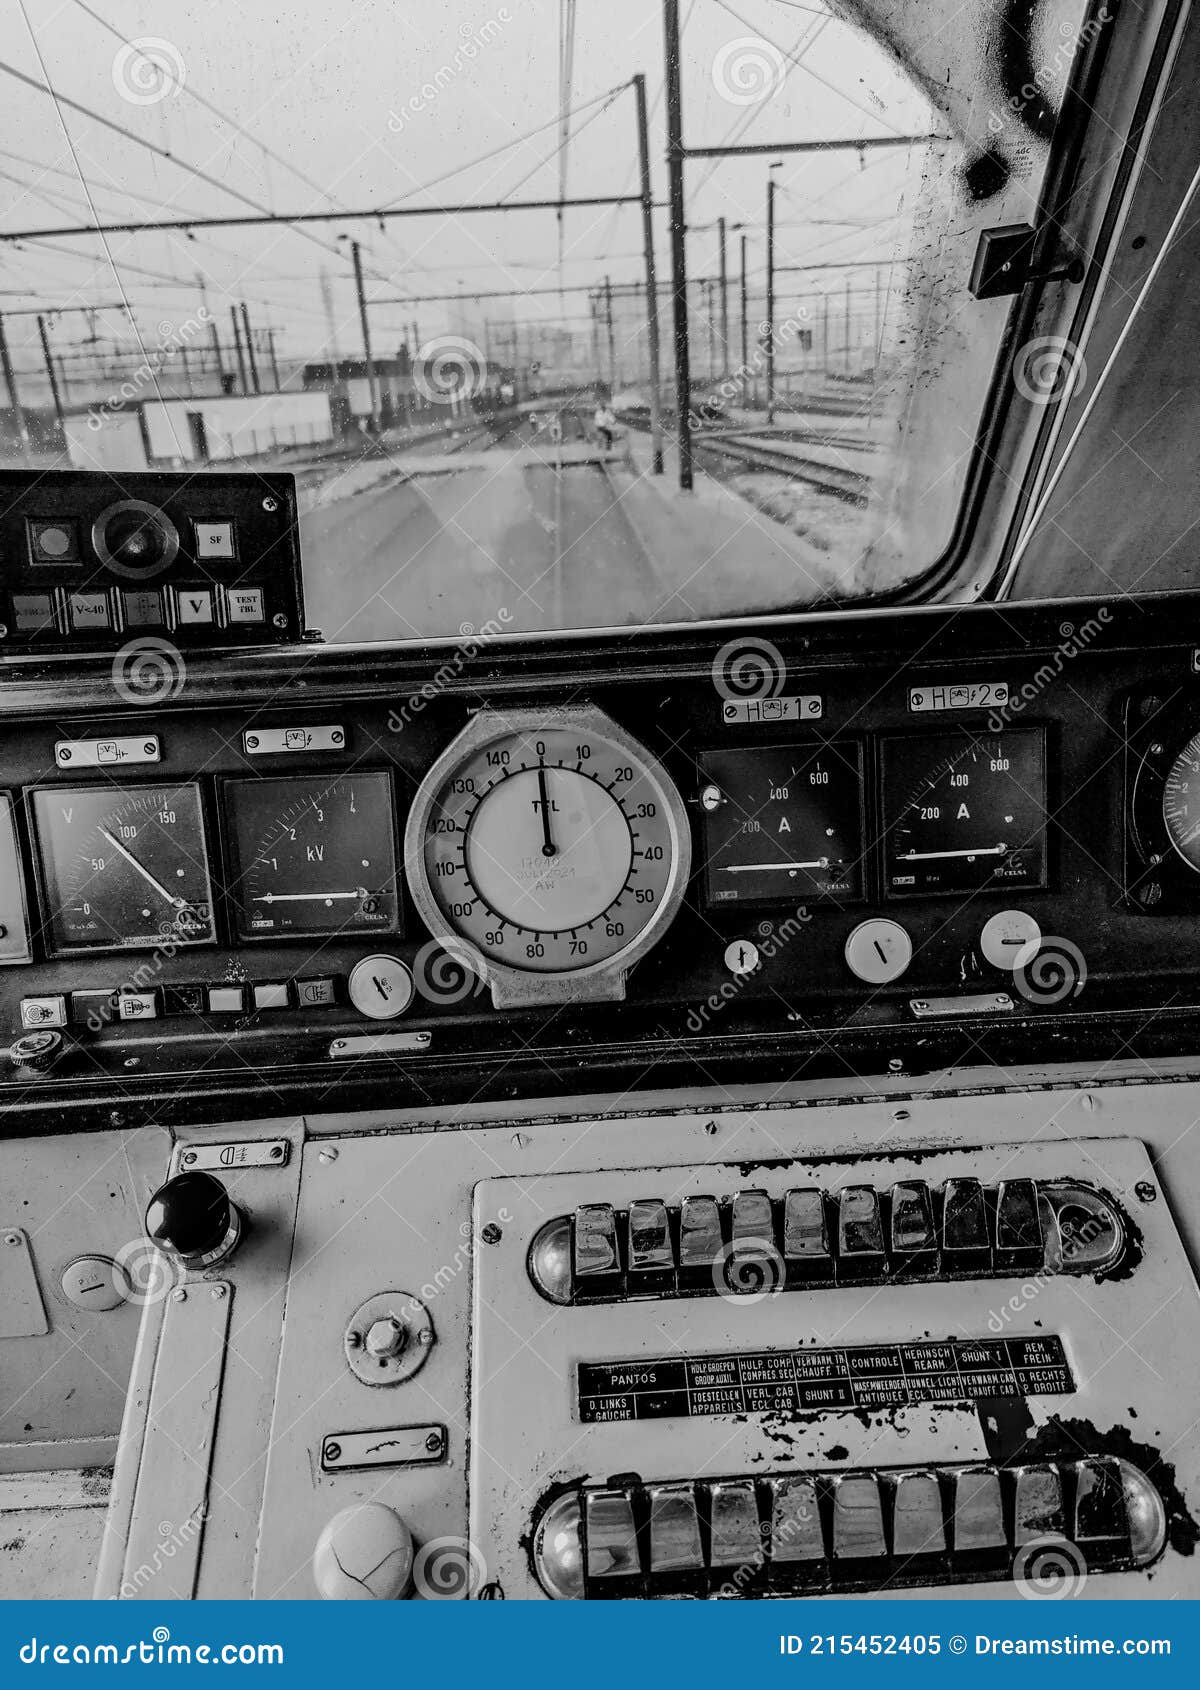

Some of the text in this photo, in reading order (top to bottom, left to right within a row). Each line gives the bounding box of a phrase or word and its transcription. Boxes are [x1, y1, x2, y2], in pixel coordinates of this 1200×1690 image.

[209, 535, 223, 545] SF
[235, 595, 258, 605] TEST
[75, 604, 105, 615] V<40
[188, 600, 204, 614] V
[238, 605, 257, 614] TBL
[979, 684, 991, 706] 2
[794, 697, 802, 720] 1
[535, 741, 546, 756] 0
[576, 745, 591, 760] 10
[486, 751, 511, 766] 140
[990, 759, 1010, 772] 600
[615, 767, 633, 782] 20
[810, 772, 829, 785] 600
[950, 774, 969, 787] 400
[451, 778, 475, 794] 130
[1182, 782, 1190, 794] 2
[770, 787, 789, 800] 400
[532, 800, 560, 814] TL
[637, 803, 656, 818] 30
[920, 807, 940, 819] 200
[957, 803, 970, 819] A
[62, 807, 73, 824] V
[158, 810, 176, 824] 150
[317, 809, 324, 822] 3
[431, 818, 456, 834] 120
[742, 821, 760, 833] 200
[778, 817, 791, 833] A
[119, 825, 137, 839] 100
[289, 828, 297, 840] 2
[306, 845, 324, 862] kV
[644, 846, 664, 861] 40
[92, 858, 105, 871] 50
[271, 858, 278, 871] 1
[435, 862, 455, 877] 110
[635, 889, 655, 904] 50
[83, 903, 90, 915] 0
[449, 902, 473, 918] 100
[605, 922, 625, 937] 60
[485, 931, 504, 946] 90
[526, 944, 545, 958] 80
[568, 941, 588, 956] 70
[1024, 1342, 1045, 1353] REM
[851, 1356, 899, 1368] CONTROLE
[961, 1350, 991, 1362] SHUNT
[611, 1373, 657, 1385] PANTOS
[1029, 1370, 1066, 1381] RECHTS
[907, 1377, 936, 1389] TUNNEL
[692, 1390, 740, 1403] TOESTELLEN
[805, 1389, 834, 1401] SHUNT
[929, 1387, 963, 1399] TUNNEL
[600, 1398, 627, 1410] LINKS
[692, 1402, 742, 1415] APPAREILS
[595, 1409, 632, 1421] GAUCHE
